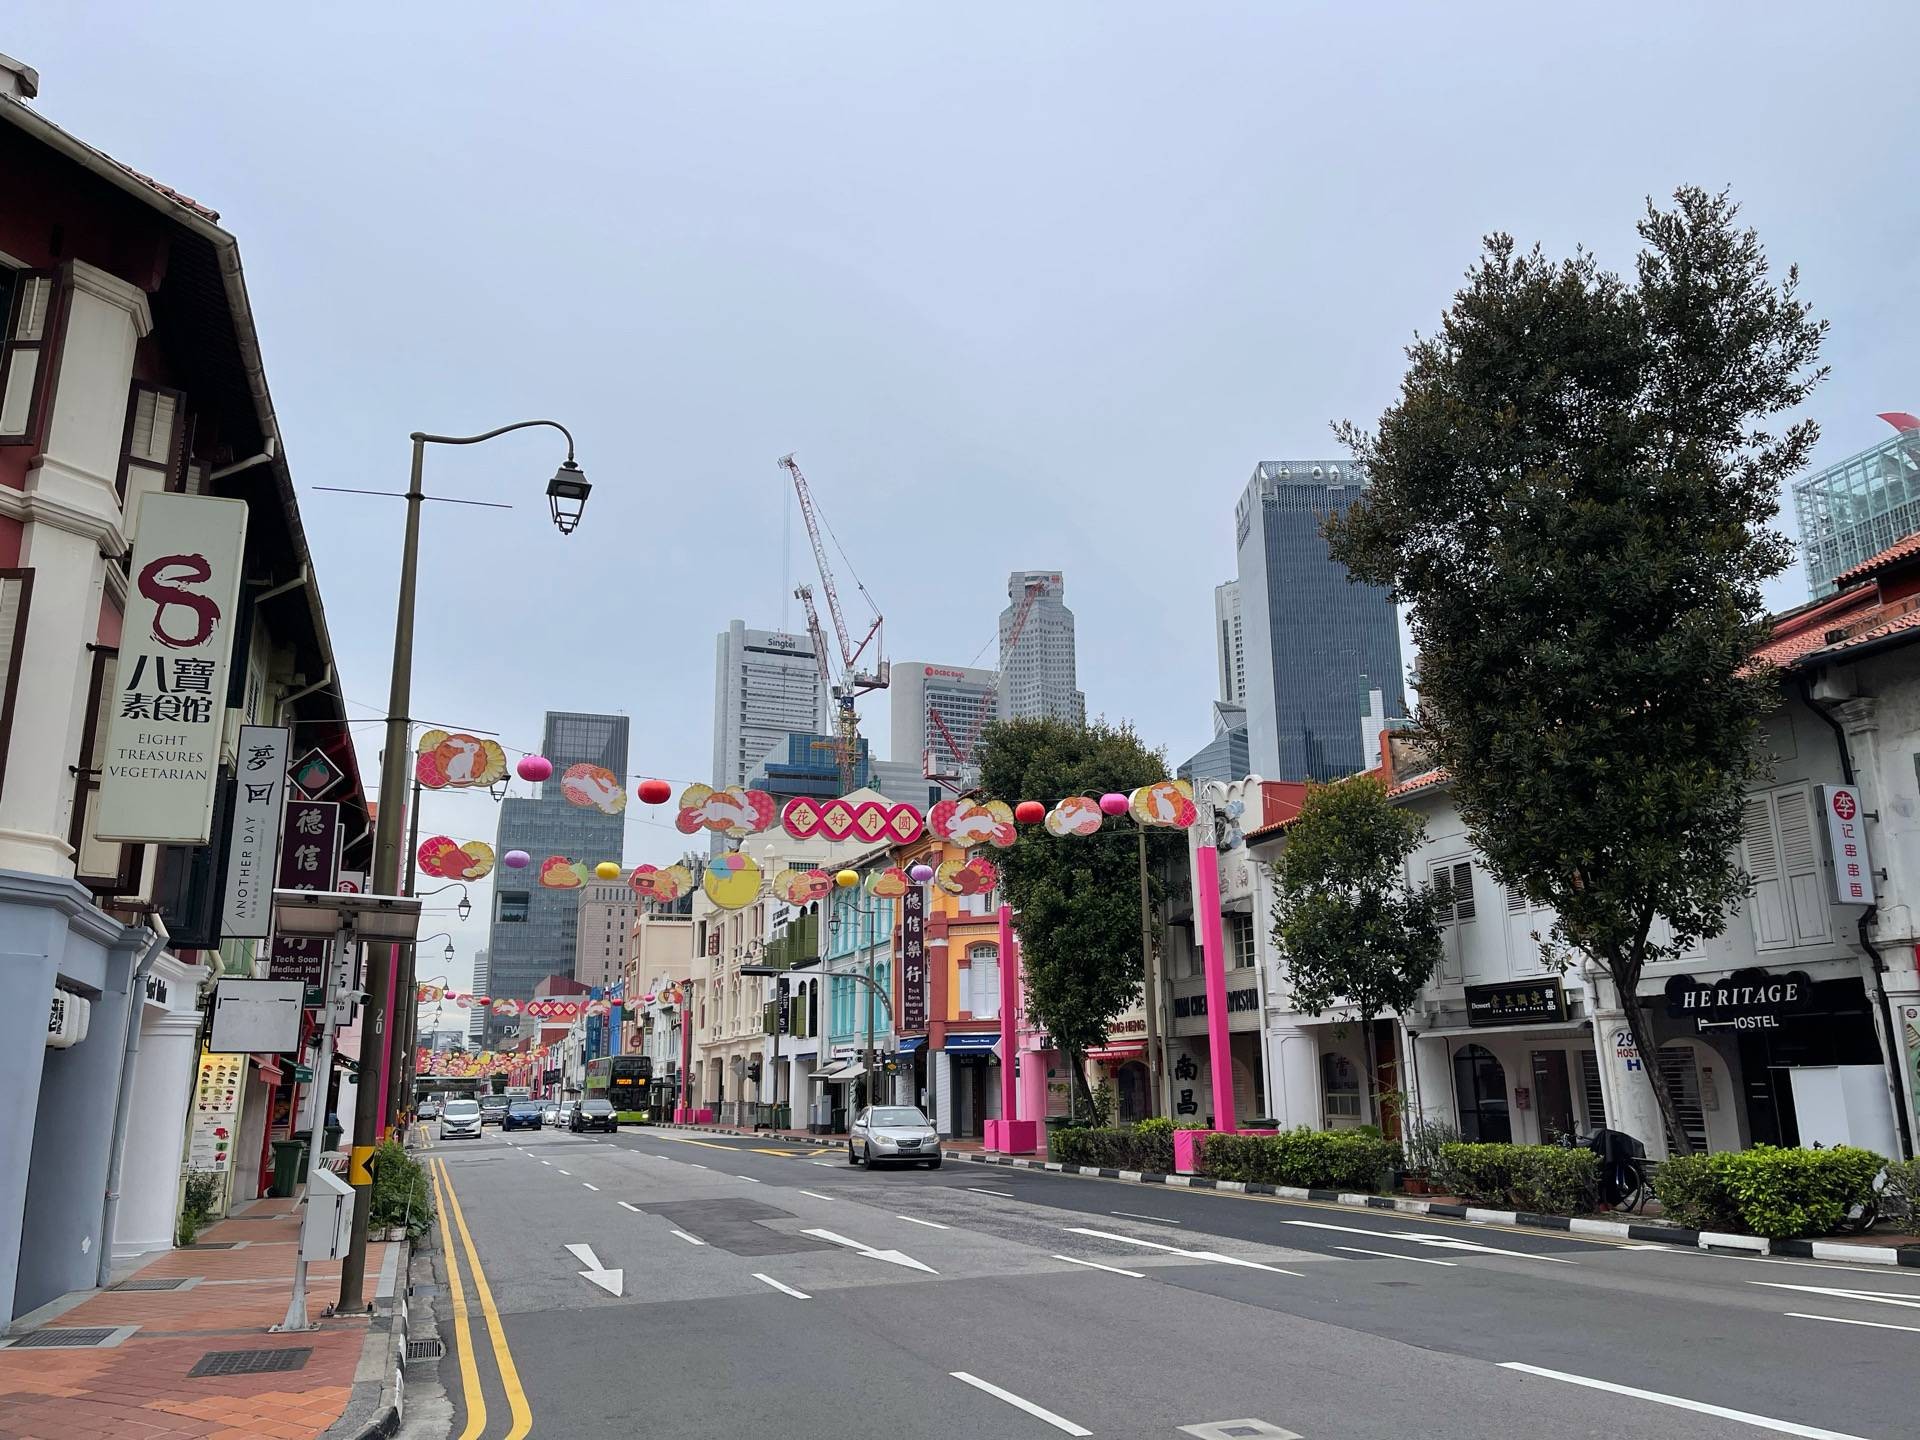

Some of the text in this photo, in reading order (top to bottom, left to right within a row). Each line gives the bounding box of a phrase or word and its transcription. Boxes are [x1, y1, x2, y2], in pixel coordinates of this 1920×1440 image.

[767, 638, 796, 650] Singtel
[126, 655, 215, 695] 八寶
[934, 668, 951, 677] OCBC
[120, 693, 213, 723] 素食馆
[138, 733, 187, 746] EIGHT
[118, 749, 204, 763] TREASURES
[109, 766, 208, 781] VEGETARIAN
[235, 816, 257, 919] ANOTHER DAY
[275, 955, 295, 963] Teck
[271, 965, 302, 973] Medical
[1682, 983, 1798, 1009] HERITAGE
[1471, 1002, 1491, 1010] Dessert
[1125, 1019, 1146, 1032] HENG
[1175, 1054, 1198, 1116] 南昌
